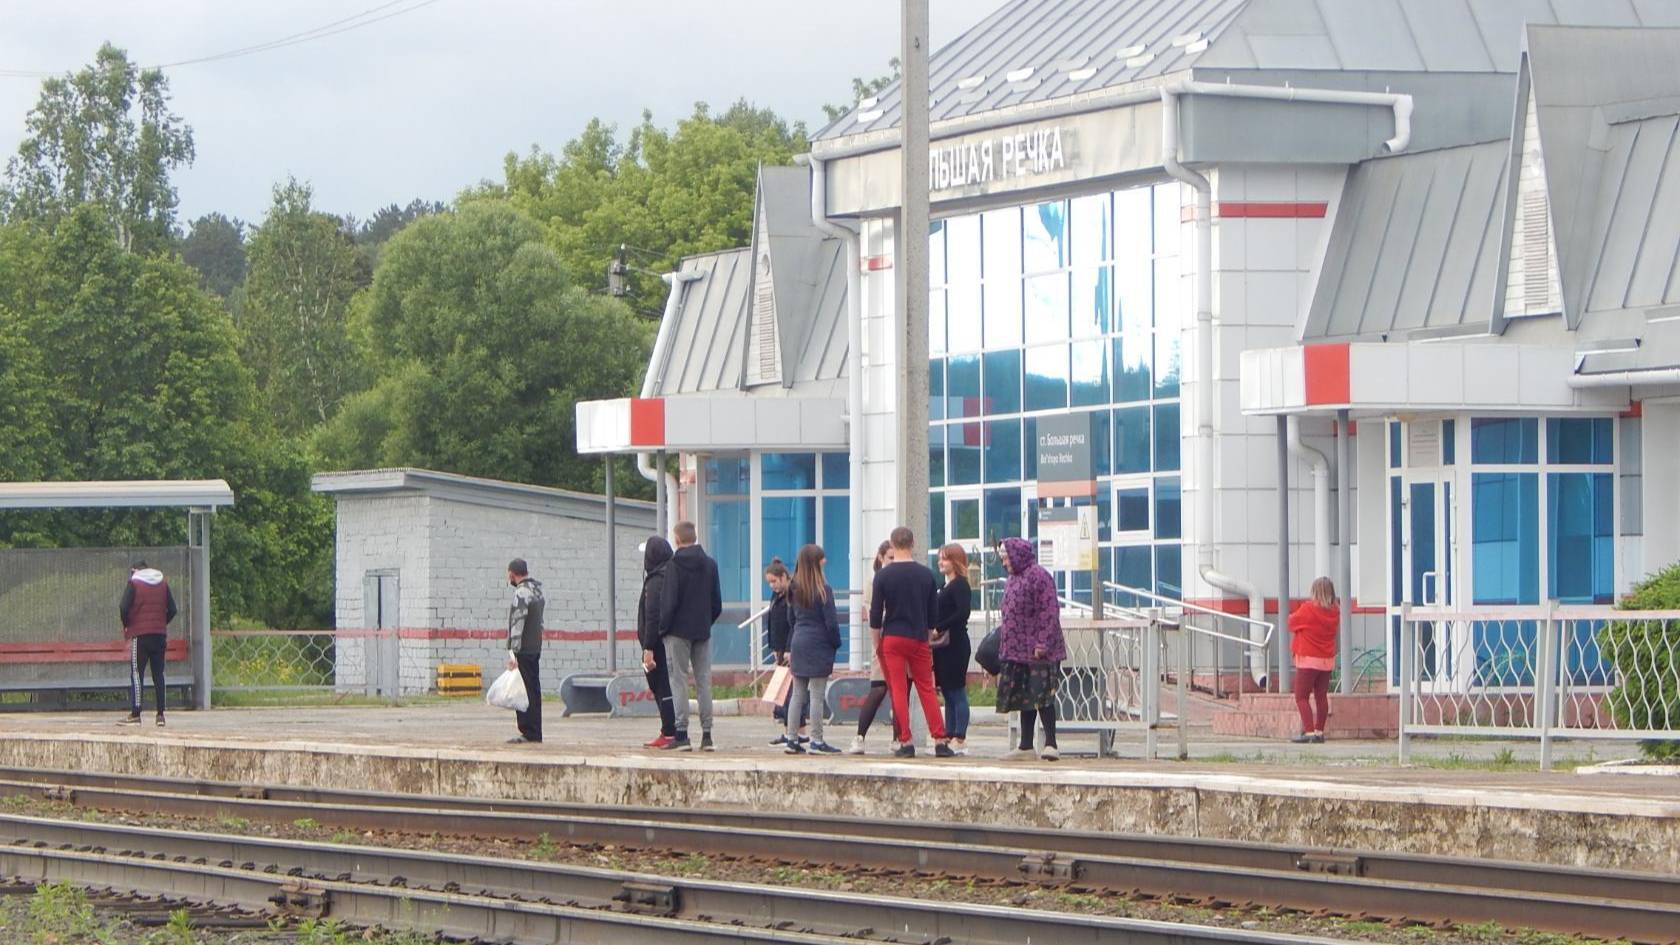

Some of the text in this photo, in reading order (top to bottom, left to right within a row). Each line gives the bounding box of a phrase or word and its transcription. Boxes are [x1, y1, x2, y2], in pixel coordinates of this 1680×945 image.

[928, 126, 1064, 190] ЛЬШАЯ РЕЧКА
[1047, 433, 1069, 446] Большая
[1070, 434, 1085, 448] речка
